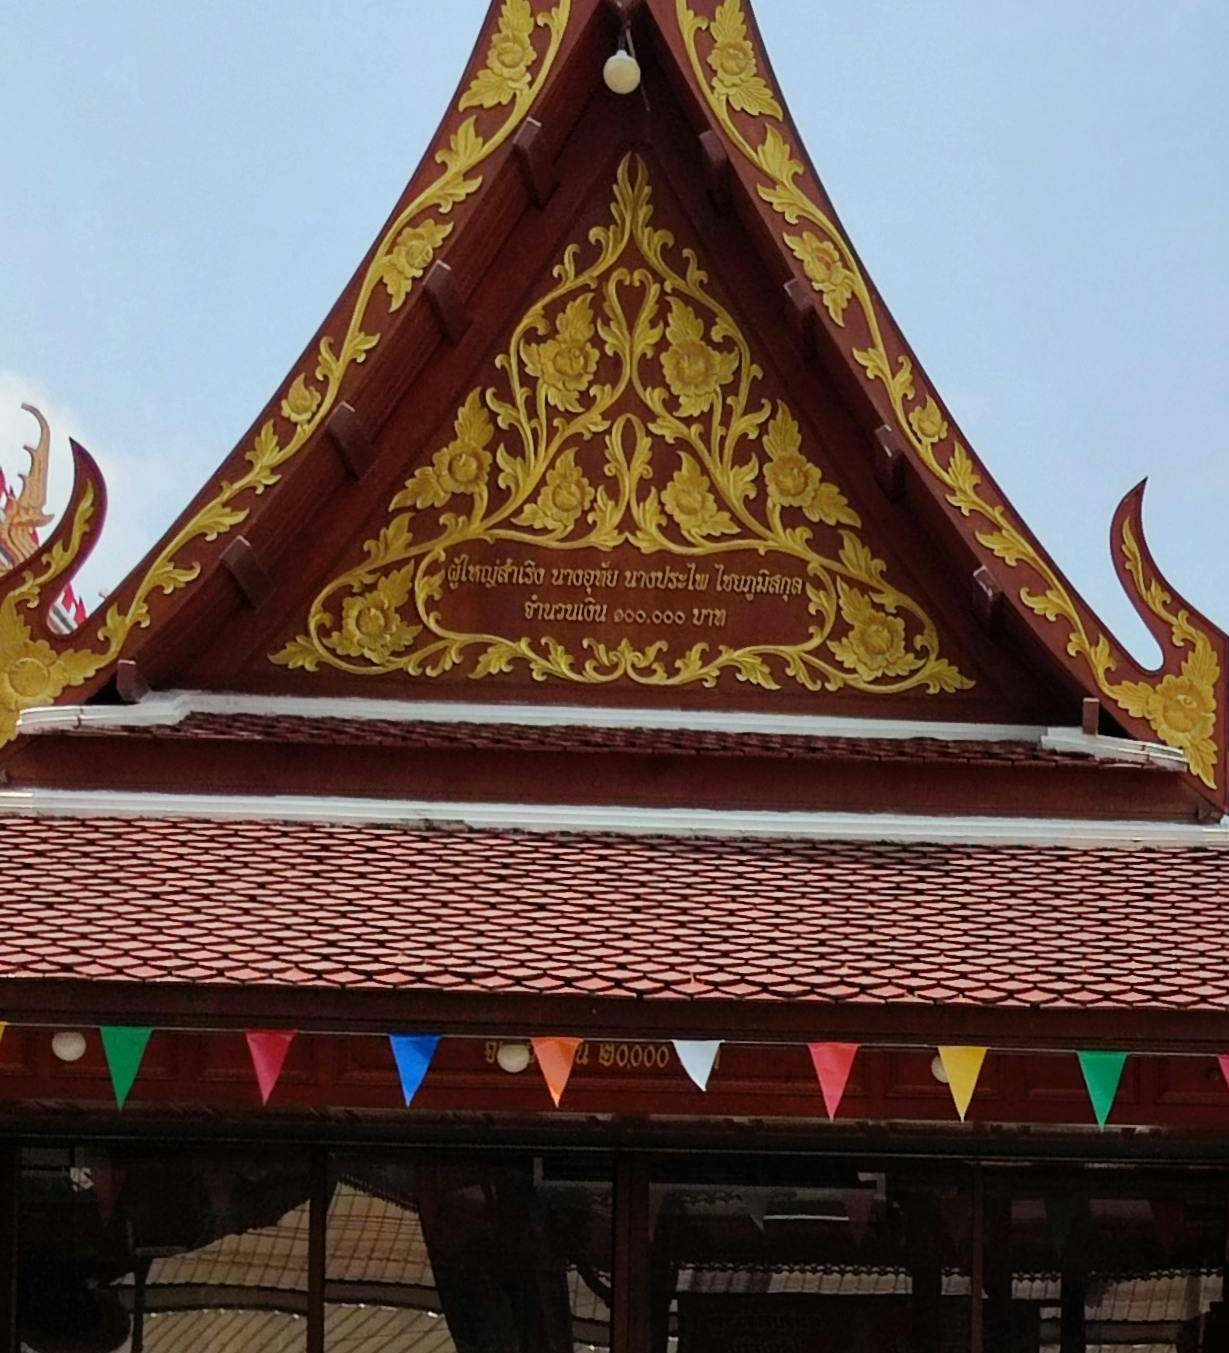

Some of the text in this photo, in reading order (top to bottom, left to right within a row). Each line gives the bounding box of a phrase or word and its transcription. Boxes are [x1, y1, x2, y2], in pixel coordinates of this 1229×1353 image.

[552, 561, 619, 595] นางอุทัย
[625, 562, 709, 591] นางประไพ
[524, 594, 608, 623] จำนวนเงิน
[692, 607, 727, 626] บาท
